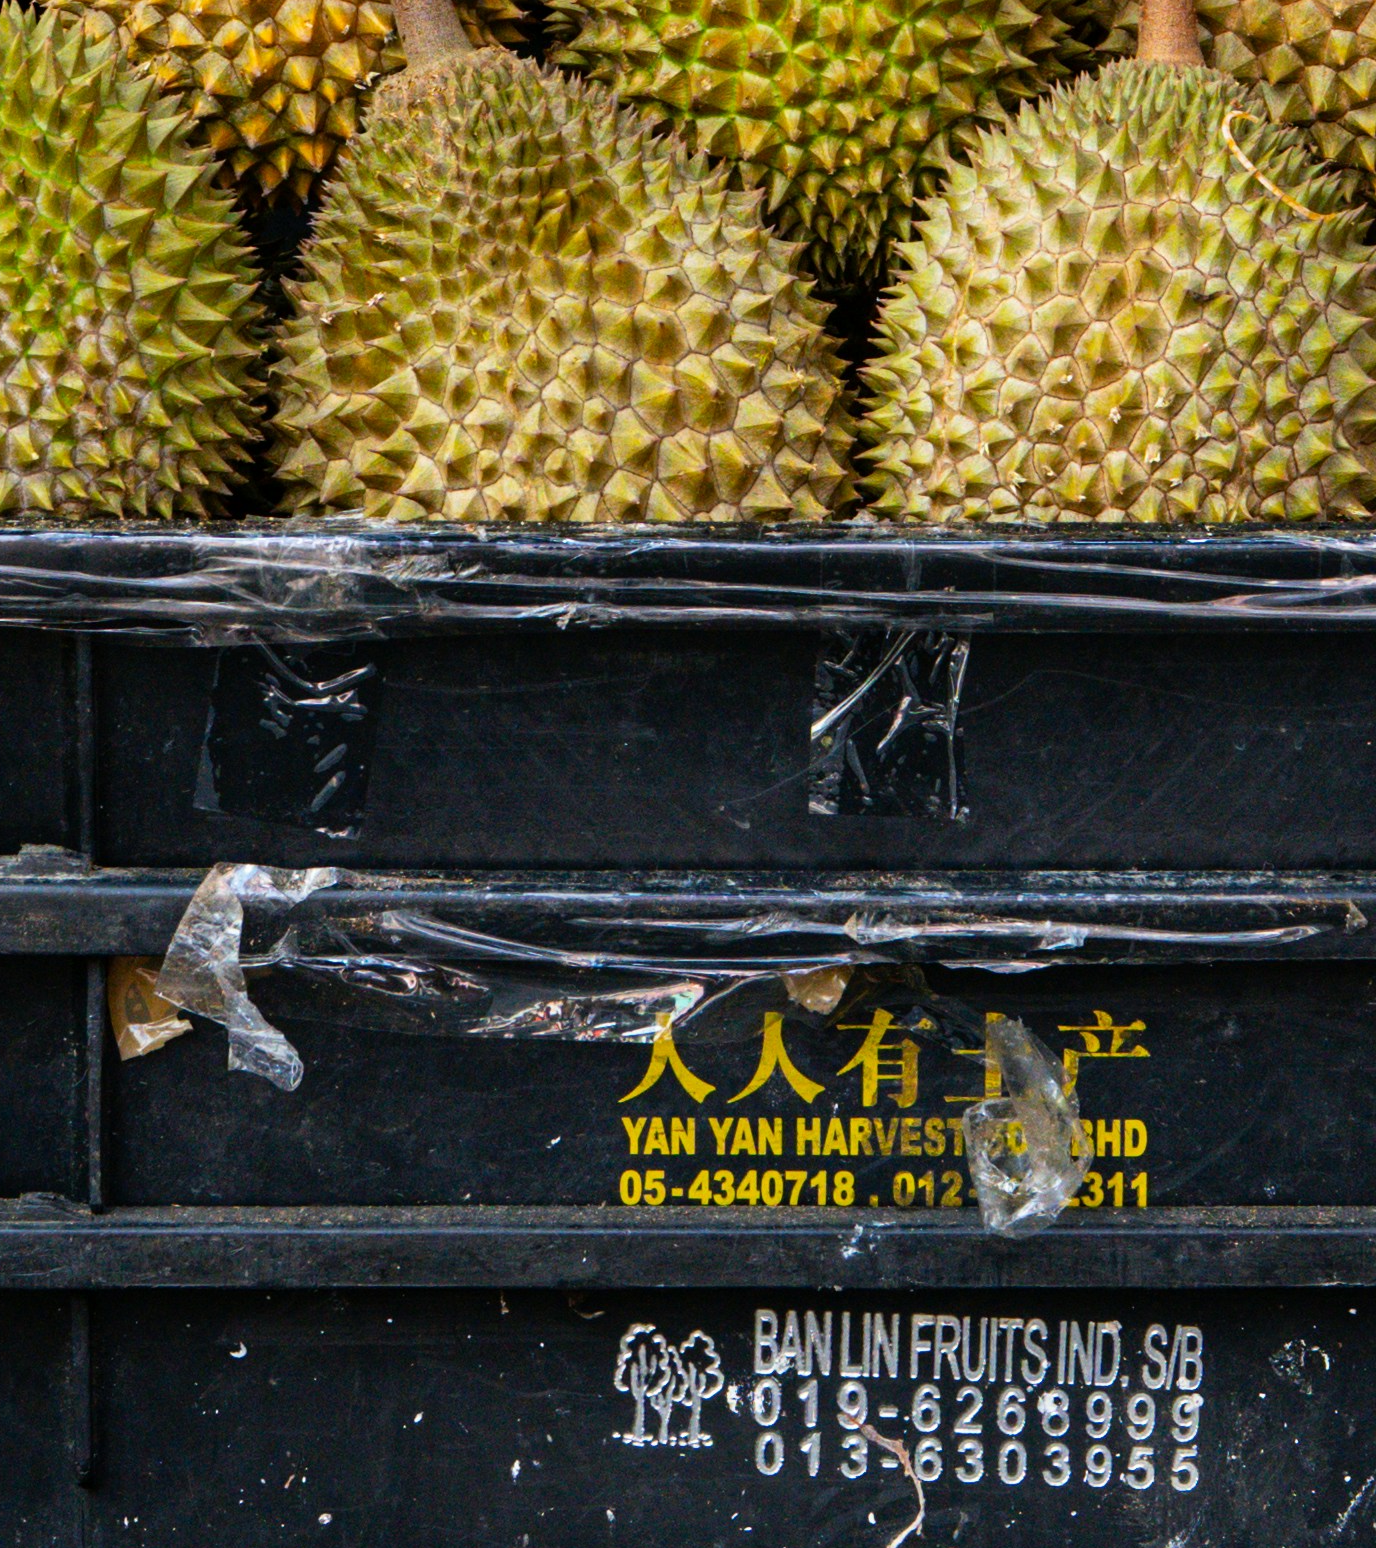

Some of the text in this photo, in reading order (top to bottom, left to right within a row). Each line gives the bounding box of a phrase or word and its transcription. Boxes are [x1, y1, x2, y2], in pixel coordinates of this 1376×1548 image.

[622, 1116, 696, 1156] YAN
[708, 1116, 783, 1156] YAN
[796, 1116, 967, 1157] HARVEST
[1071, 1118, 1149, 1158] BHD
[619, 1170, 855, 1207] 05-4340718
[754, 1309, 832, 1376] BAN
[841, 1312, 900, 1378] LIN
[910, 1314, 1048, 1385] FRUITS
[1143, 1324, 1204, 1390] S/B
[753, 1378, 1203, 1442] 019-6268999
[755, 1431, 1200, 1492] 013-6303955
